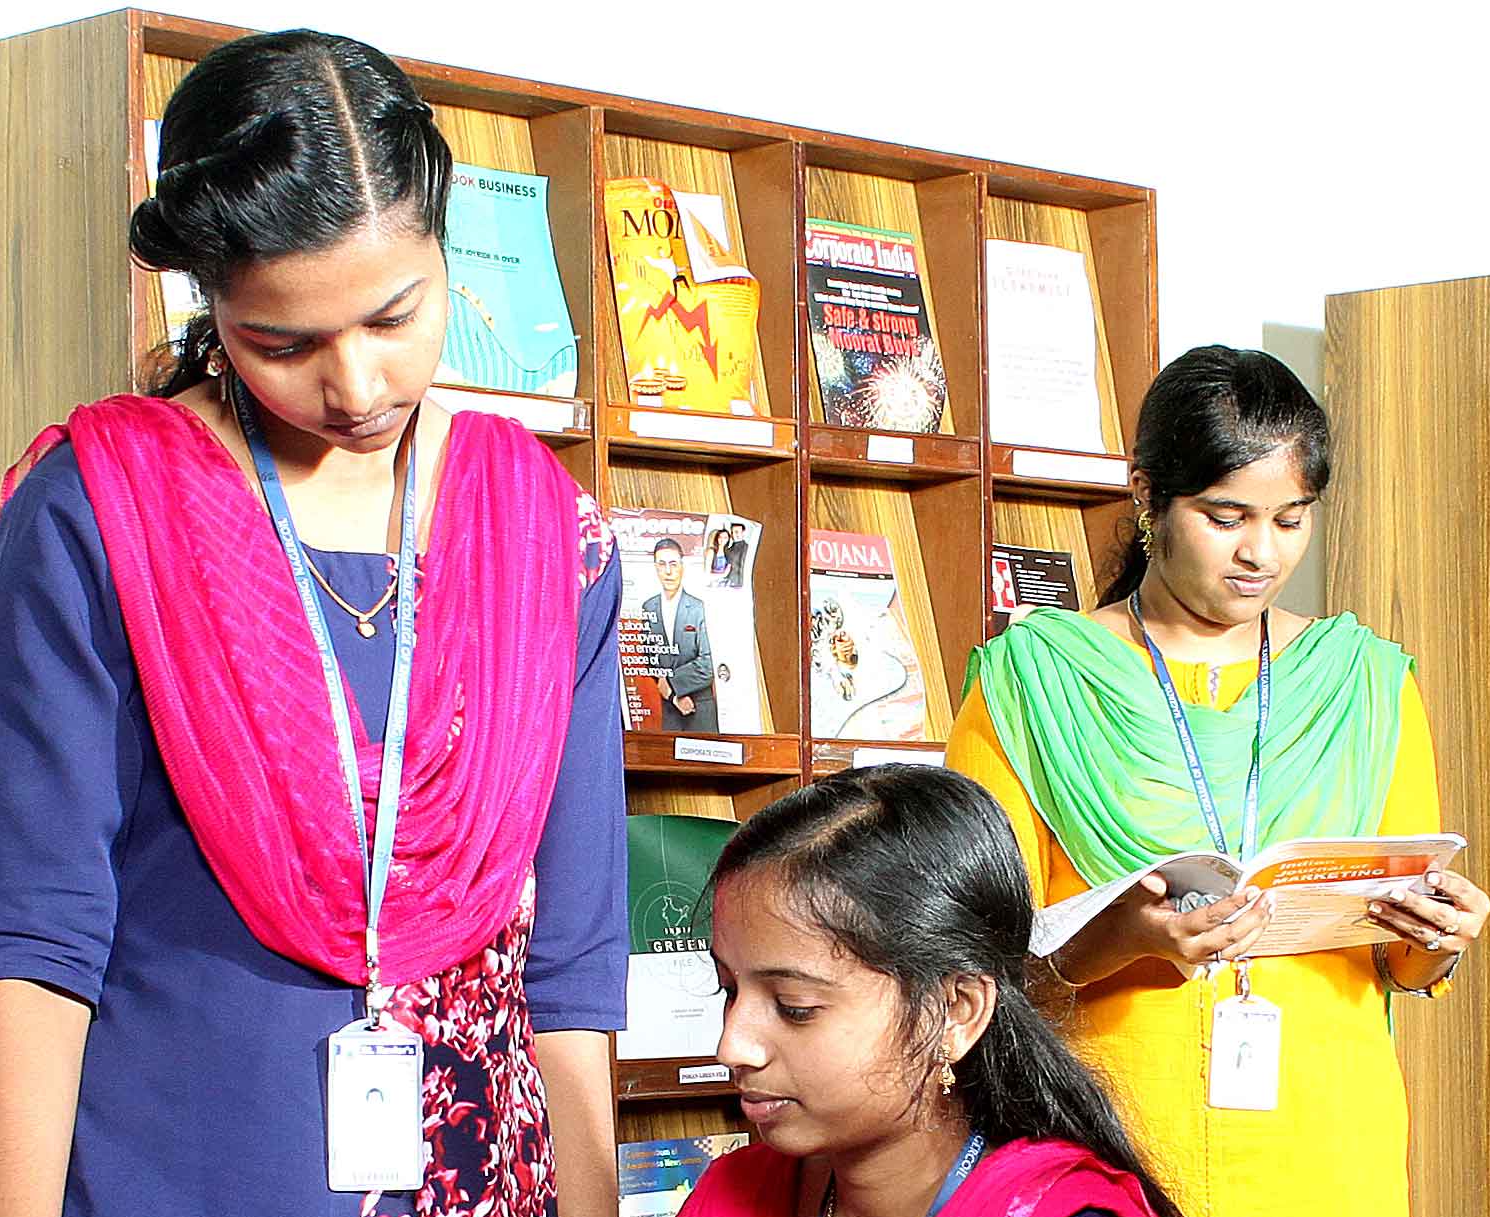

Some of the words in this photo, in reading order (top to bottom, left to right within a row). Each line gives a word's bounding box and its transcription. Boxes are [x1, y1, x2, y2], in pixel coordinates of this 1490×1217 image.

[478, 178, 537, 198] BUSINESS
[873, 240, 917, 273] India
[823, 303, 854, 329] Safe
[857, 307, 871, 330] &
[871, 309, 919, 338] strong
[811, 538, 884, 568] YOJANA
[653, 938, 707, 953] GREEN
[951, 1133, 989, 1180] GERCOIL
